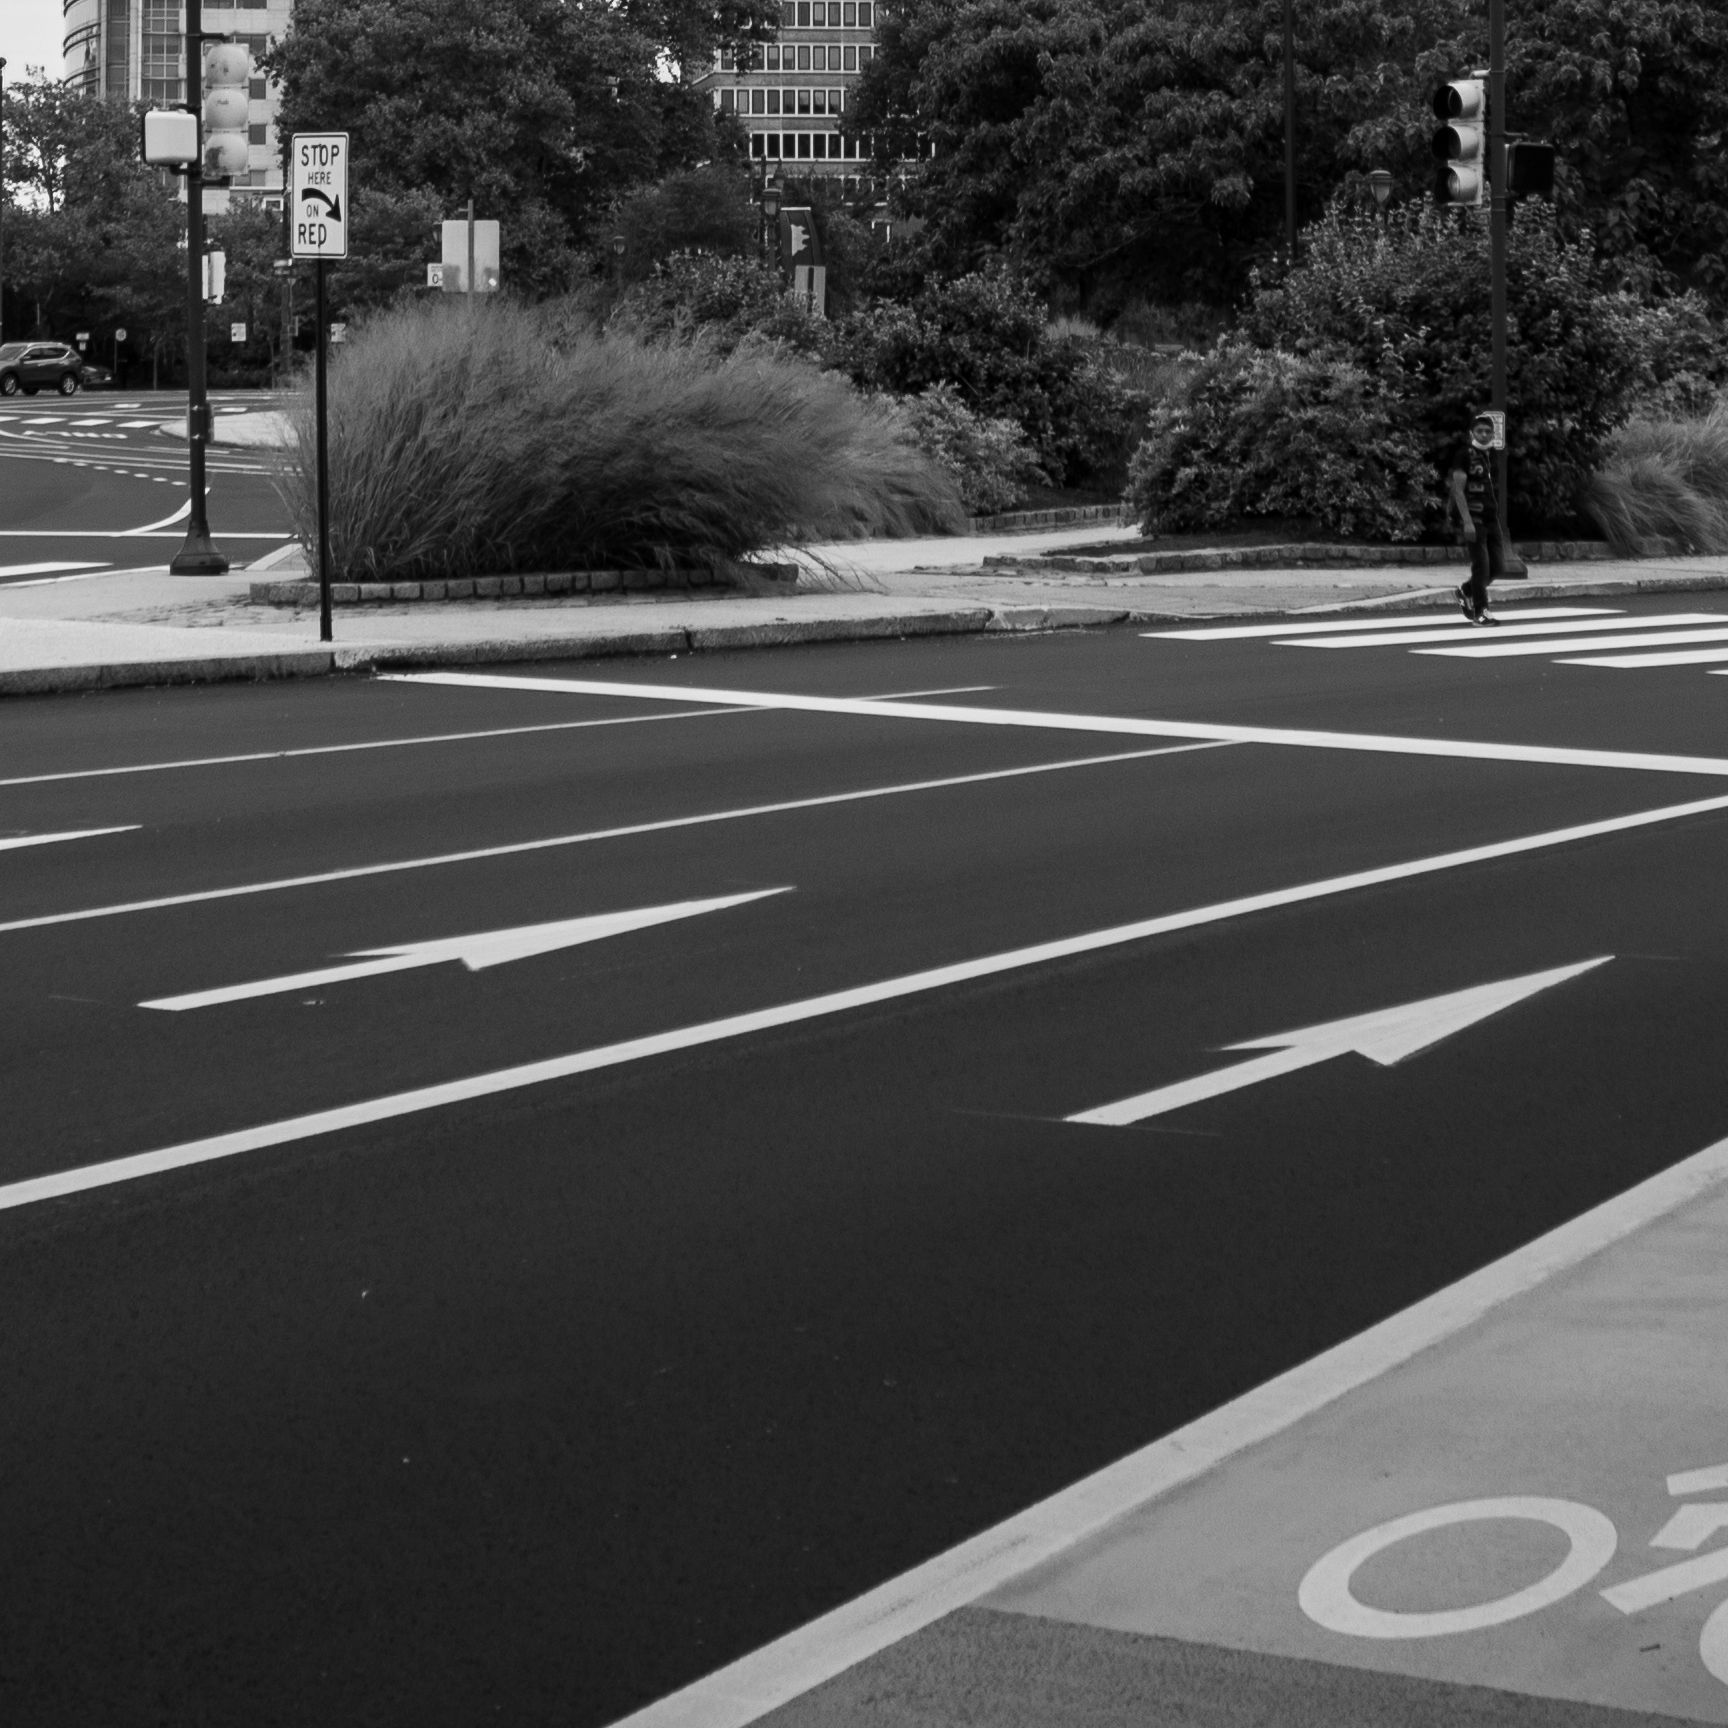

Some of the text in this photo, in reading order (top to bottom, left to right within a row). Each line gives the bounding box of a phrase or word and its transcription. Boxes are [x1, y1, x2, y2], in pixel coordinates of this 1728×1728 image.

[300, 144, 340, 167] STOP
[307, 171, 332, 185] HERE
[306, 204, 319, 218] ON
[297, 223, 327, 246] RED
